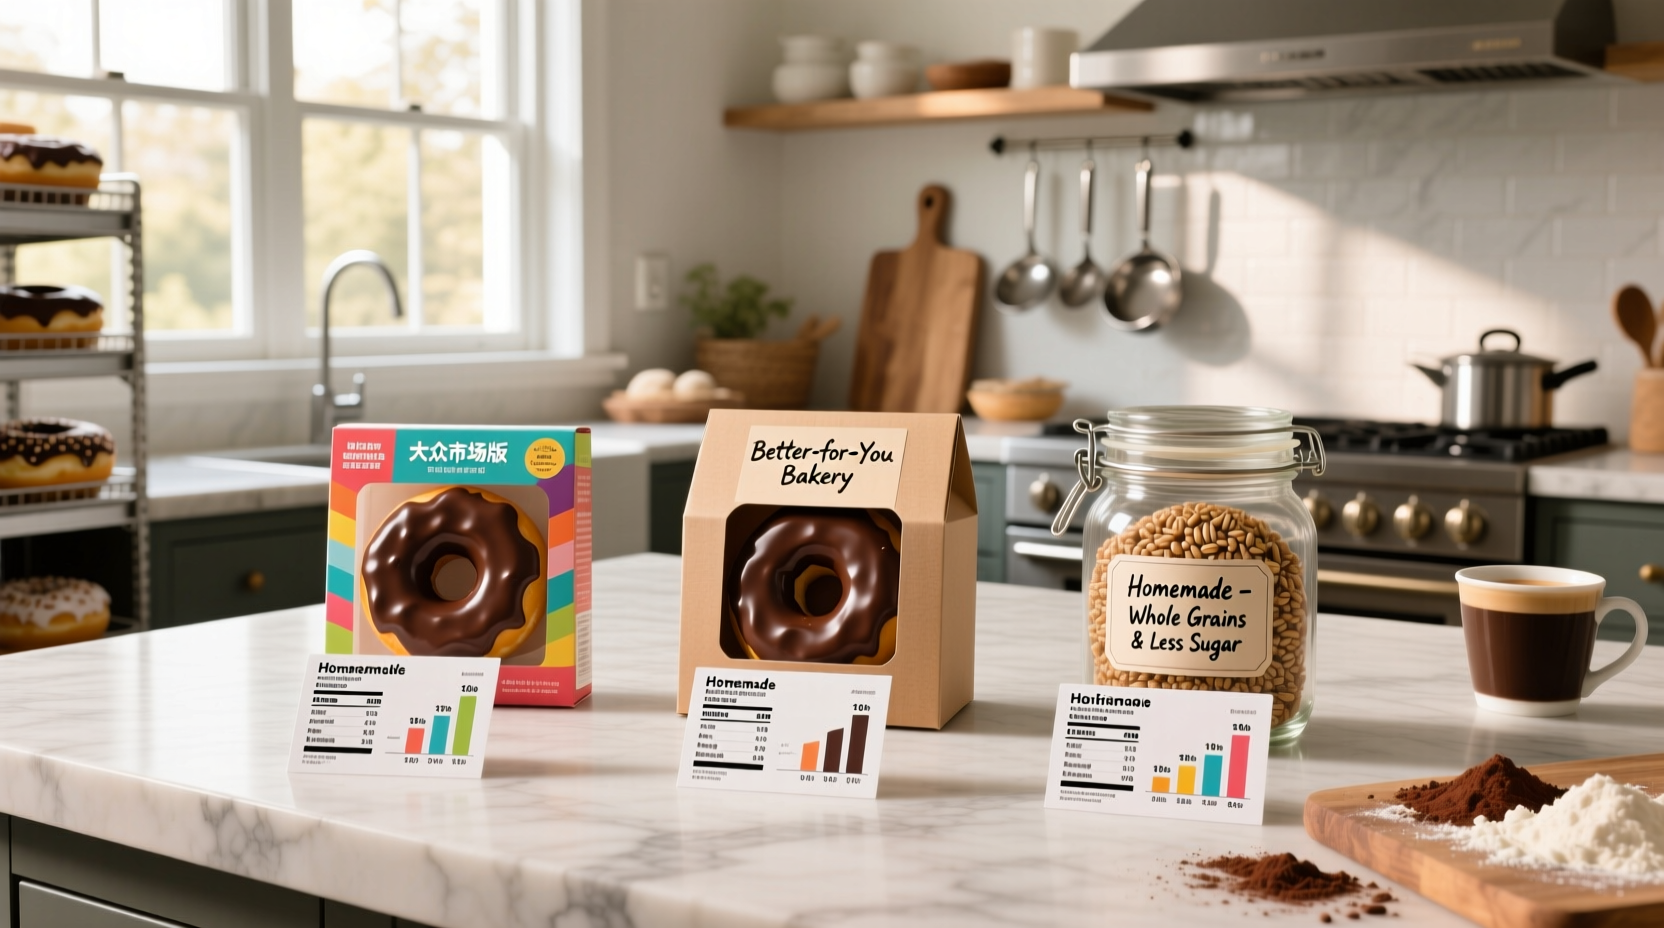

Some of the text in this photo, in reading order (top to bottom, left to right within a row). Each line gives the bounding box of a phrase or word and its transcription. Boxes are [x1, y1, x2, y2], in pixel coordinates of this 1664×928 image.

[408, 440, 508, 464] 大众市场版
[750, 438, 894, 465] Better-for-You
[780, 463, 854, 494] Bakery
[1127, 573, 1233, 600] Homemade
[1129, 603, 1247, 628] Whole Grains
[1131, 630, 1243, 661] & Less Sugar
